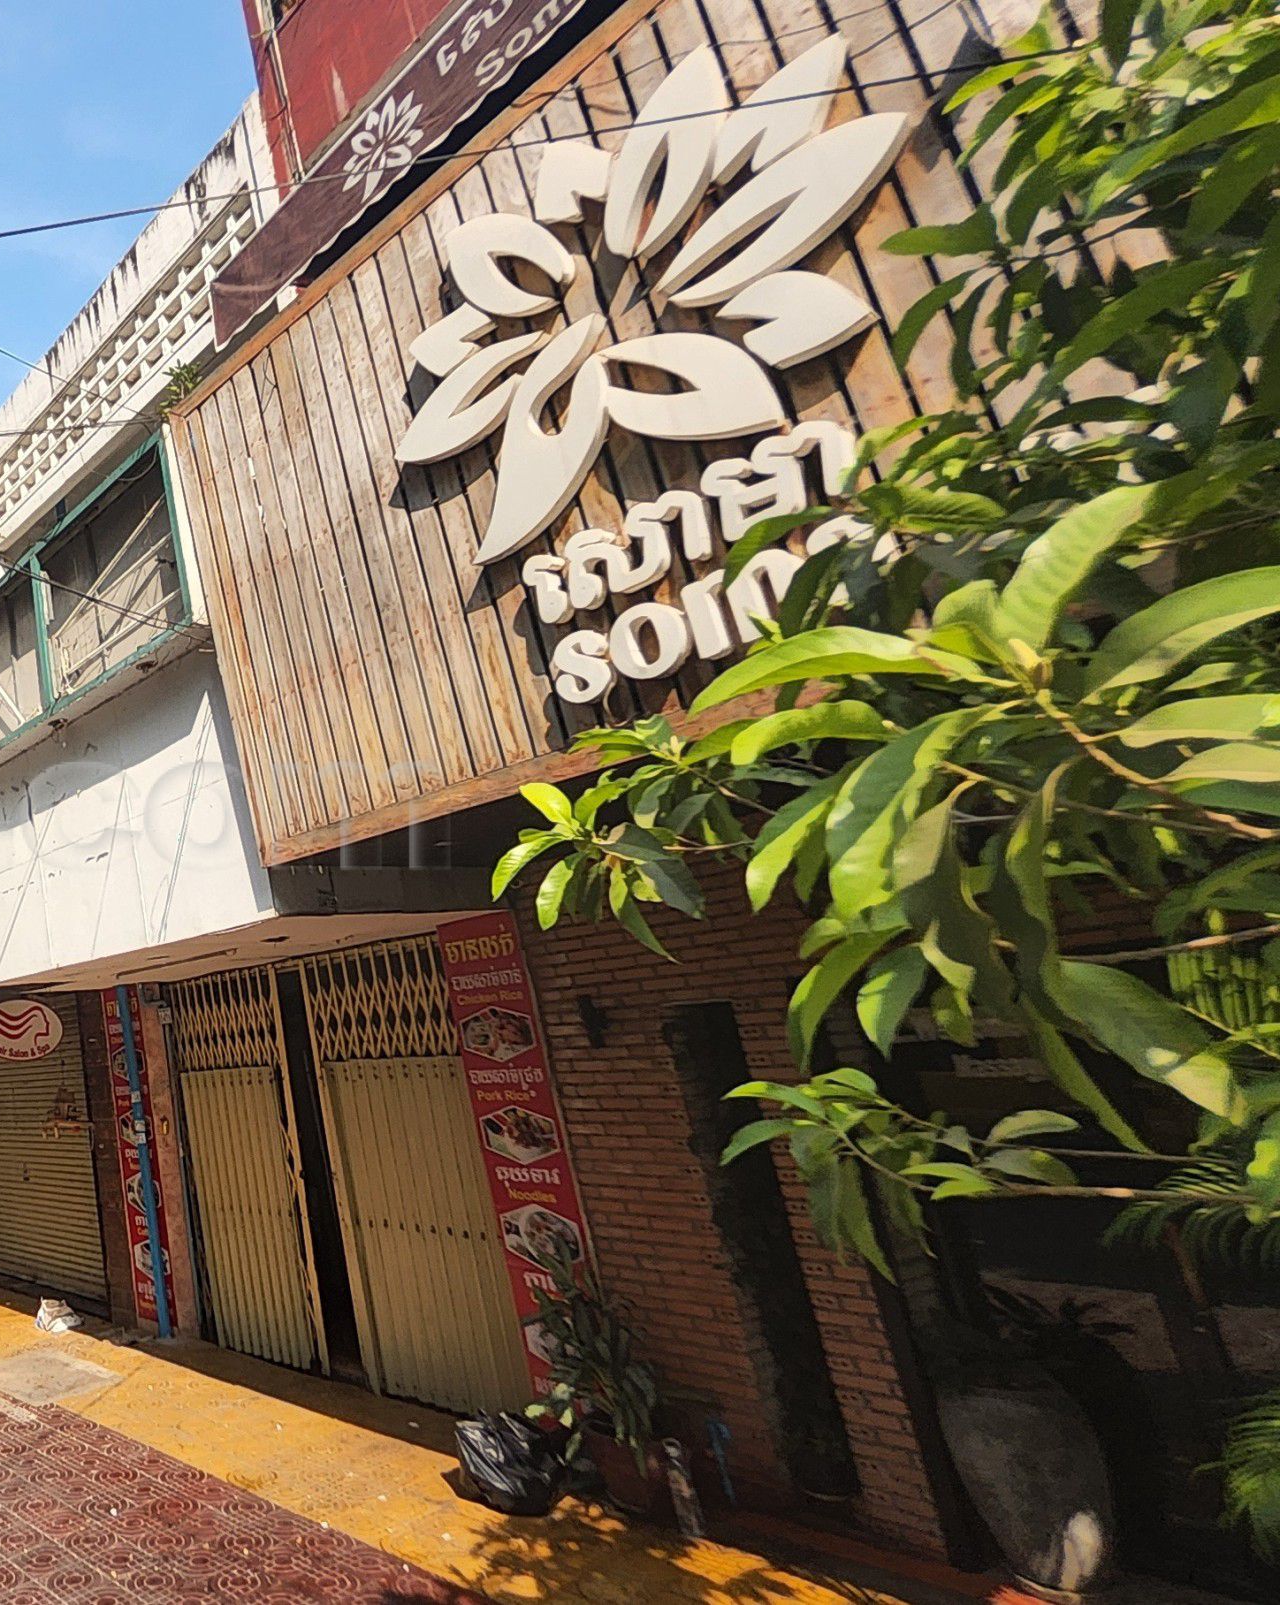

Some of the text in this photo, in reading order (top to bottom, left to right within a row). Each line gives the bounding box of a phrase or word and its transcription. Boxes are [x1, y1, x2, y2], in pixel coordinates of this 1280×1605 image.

[553, 514, 902, 704] som
[8, 1047, 29, 1058] Salon
[37, 1043, 50, 1057] Spa
[476, 1089, 531, 1101] Pork Rice
[508, 1188, 557, 1204] Noodles
